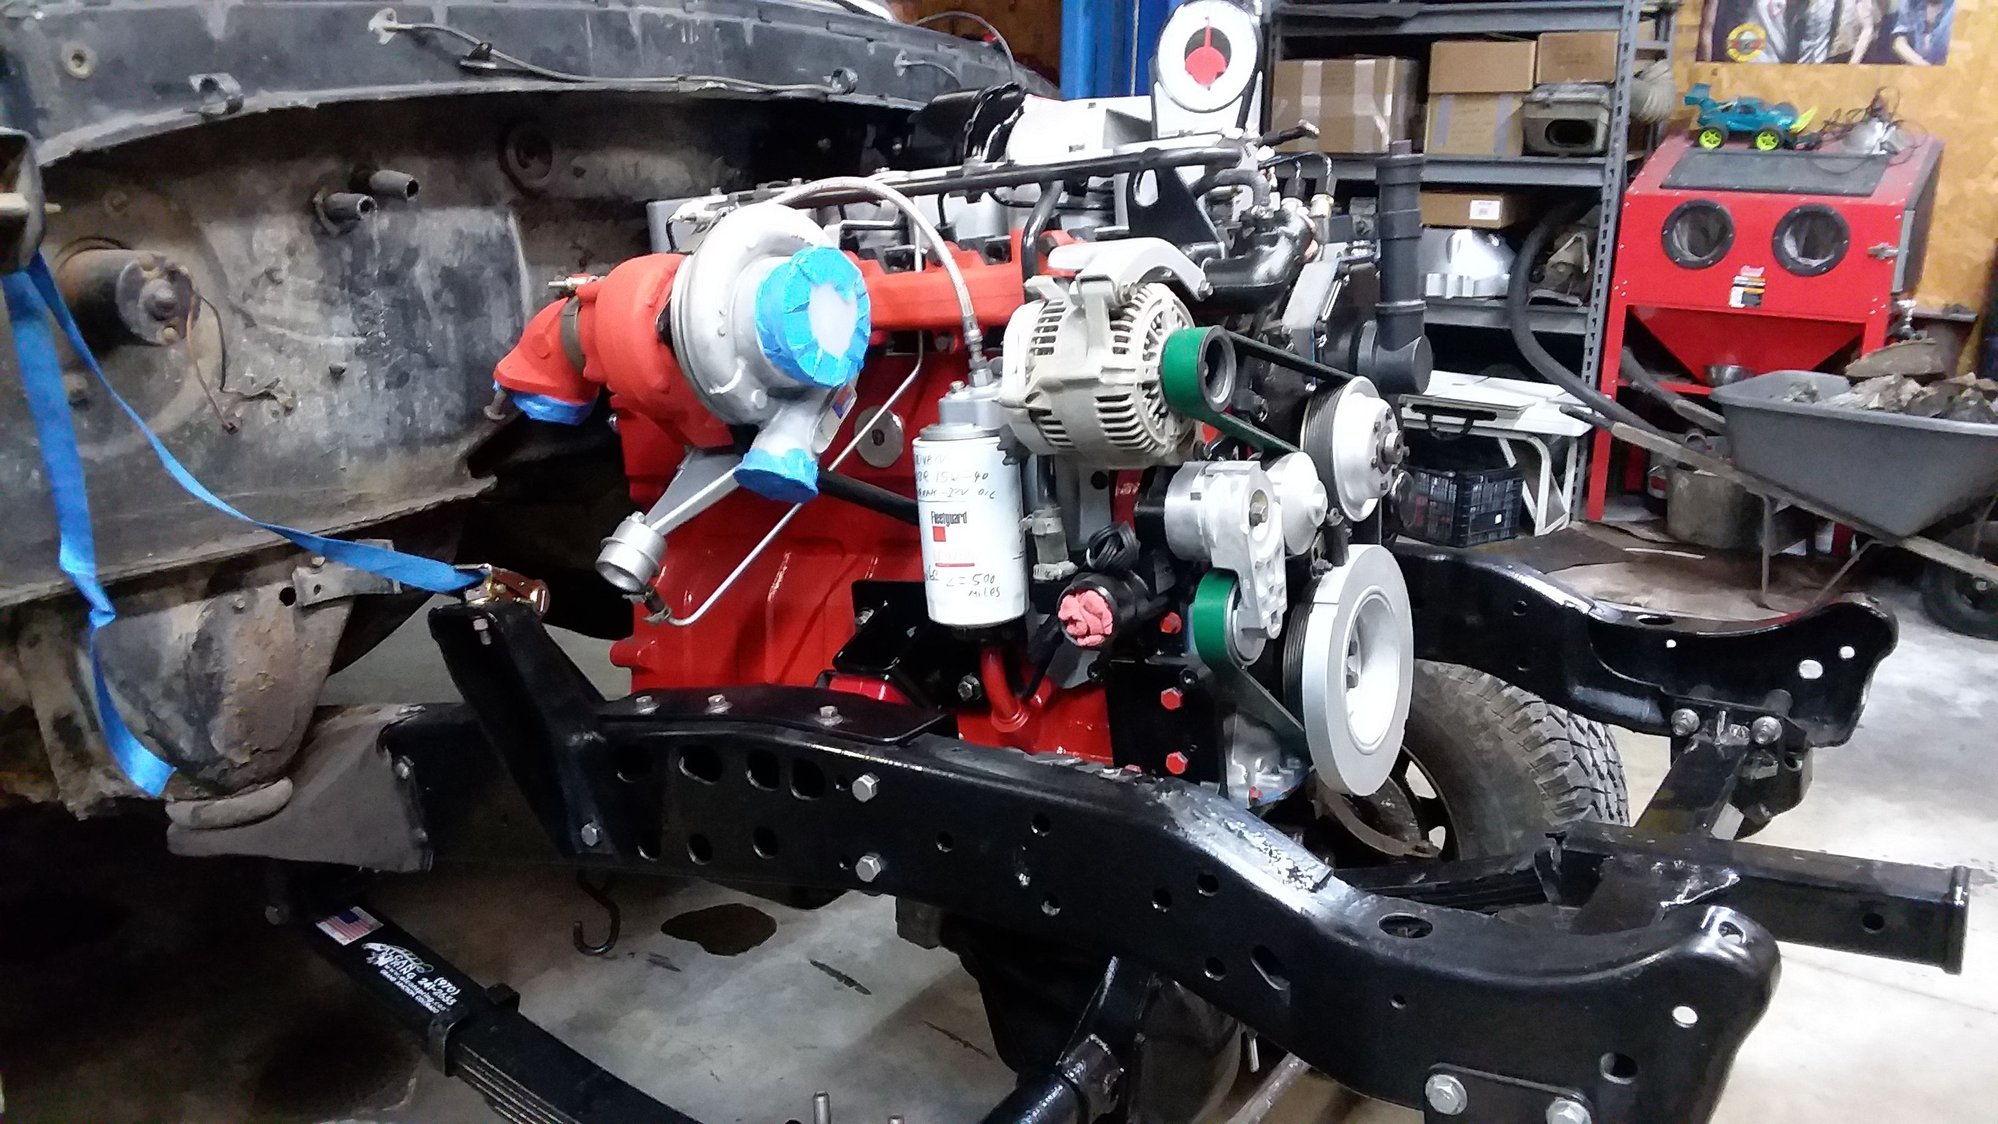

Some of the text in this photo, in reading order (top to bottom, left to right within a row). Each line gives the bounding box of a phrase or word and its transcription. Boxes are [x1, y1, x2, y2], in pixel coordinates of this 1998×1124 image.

[931, 511, 968, 527] Fleetguard
[972, 573, 995, 586] 500
[434, 976, 461, 996] (970)
